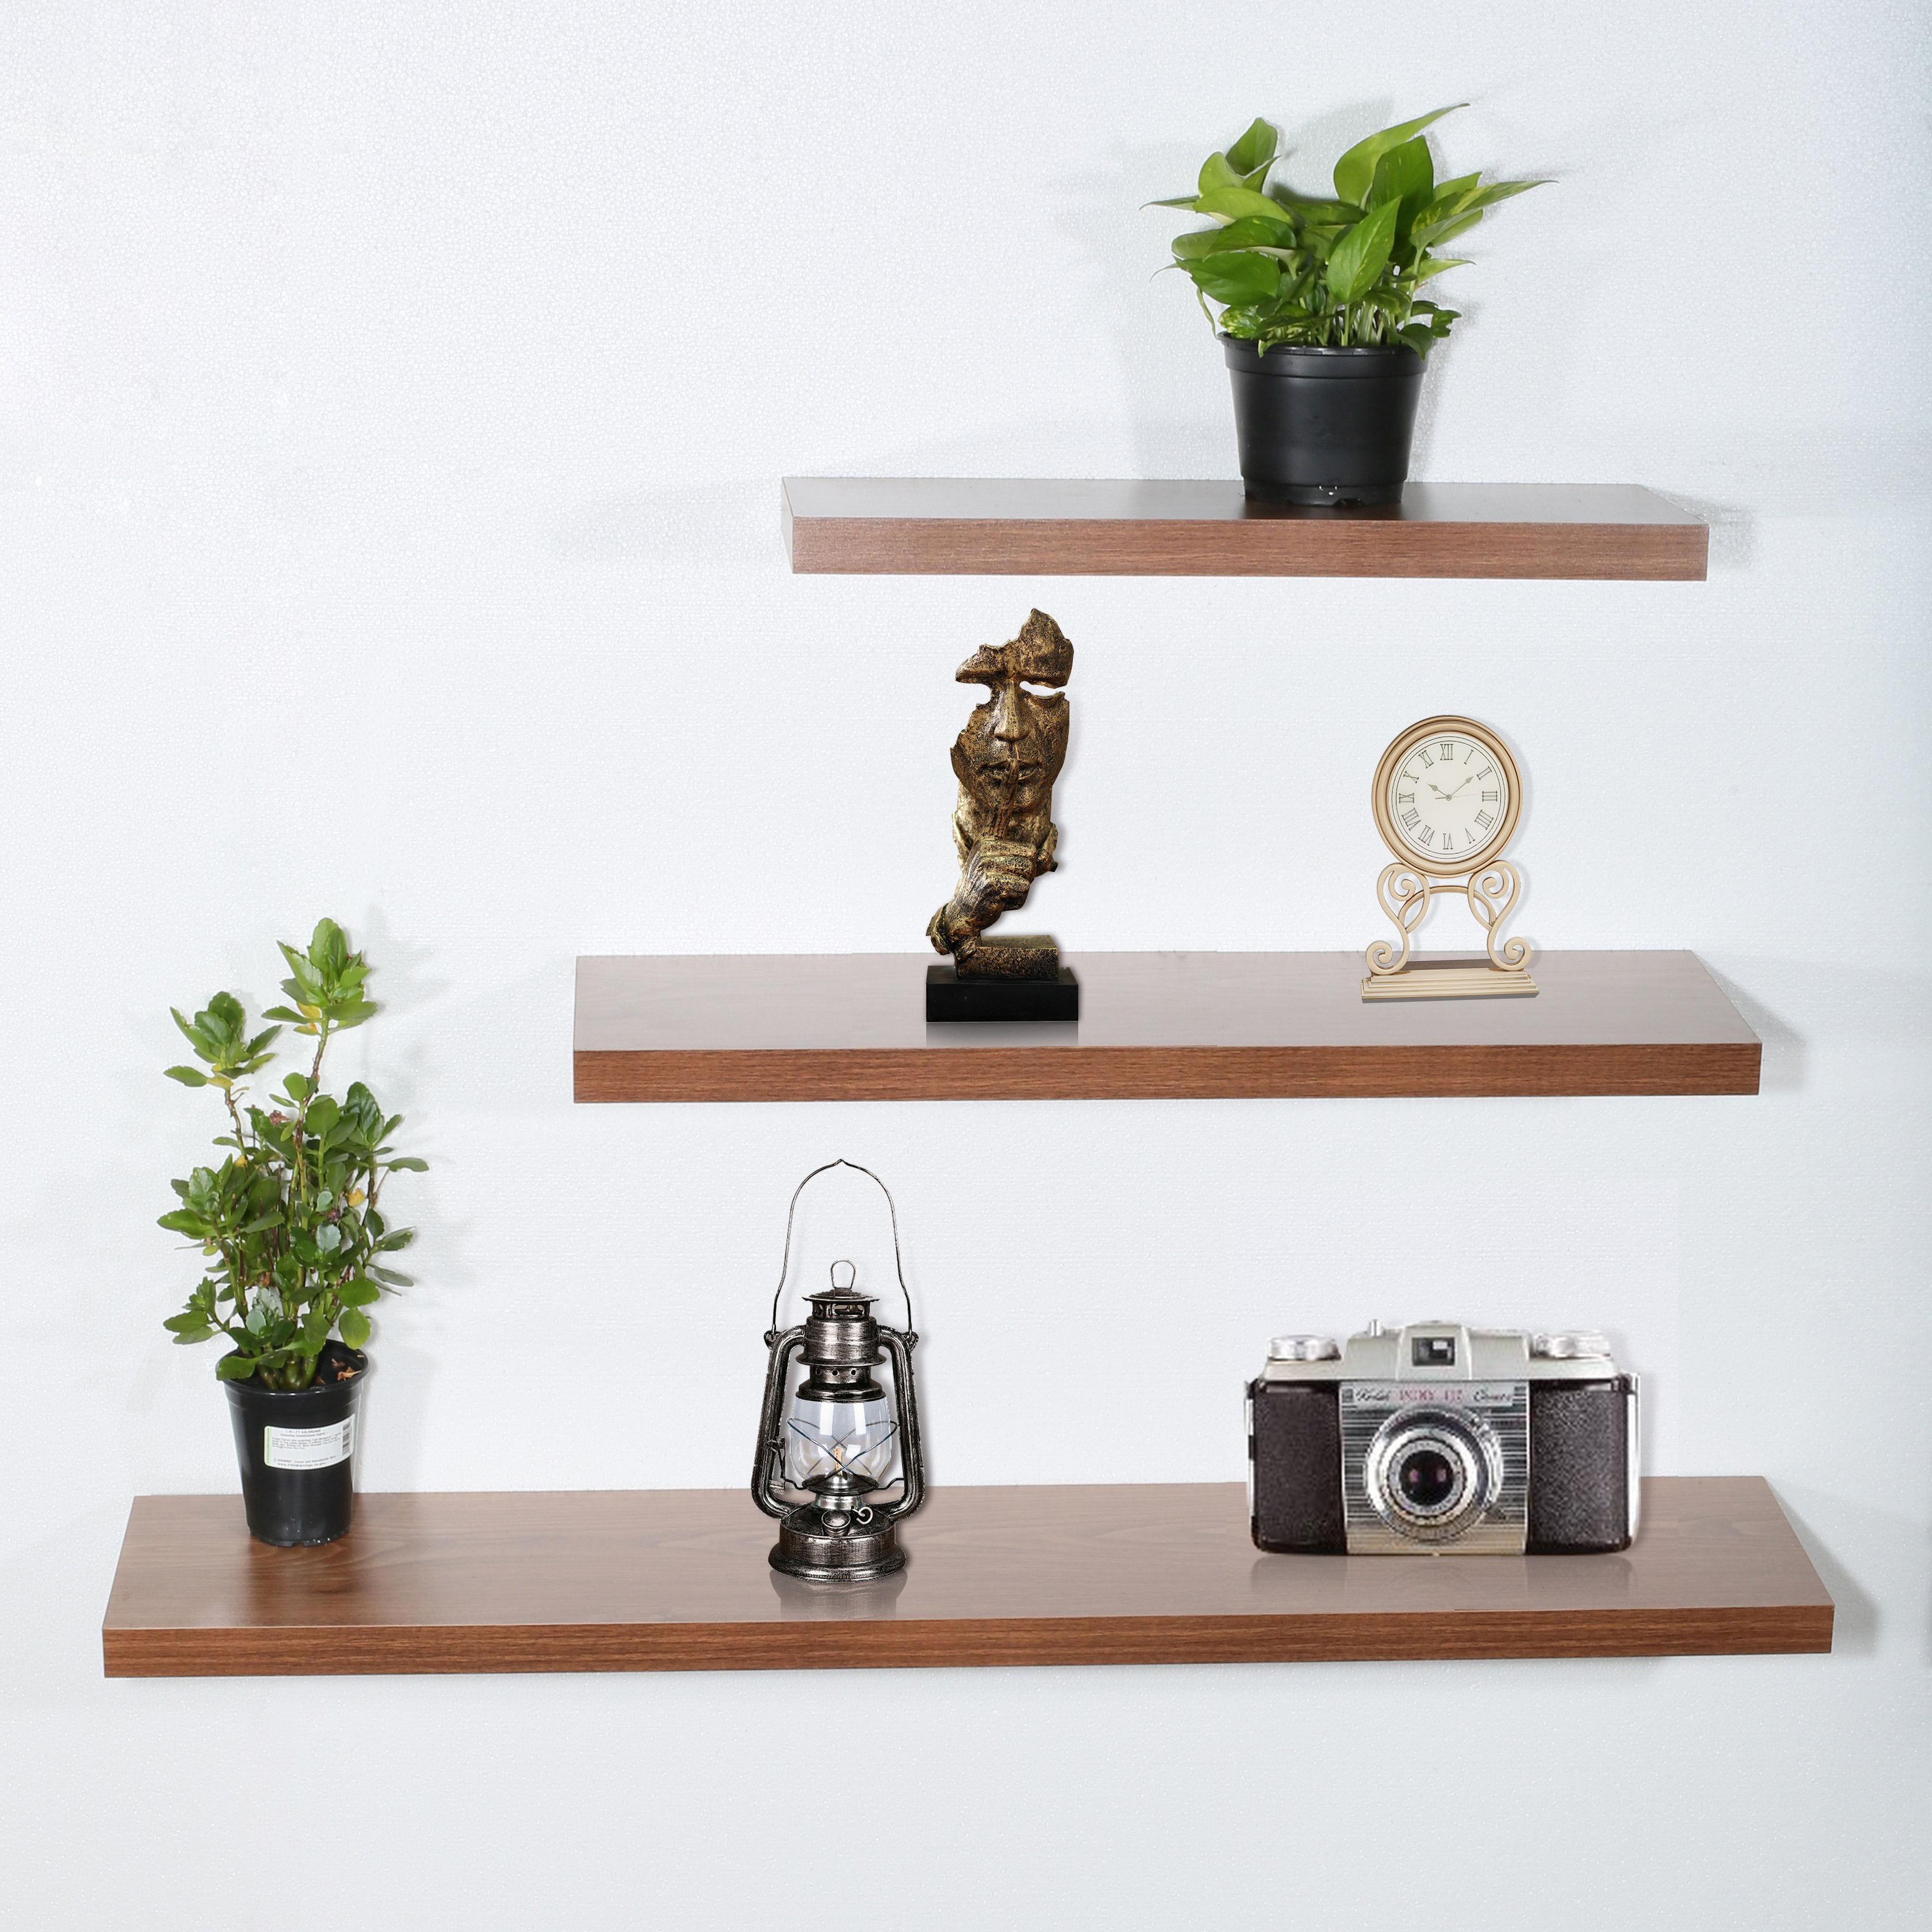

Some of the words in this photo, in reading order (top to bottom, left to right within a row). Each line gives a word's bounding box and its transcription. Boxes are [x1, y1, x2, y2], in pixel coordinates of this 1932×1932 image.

[1418, 749, 1434, 769] XI
[1440, 744, 1454, 761] XII
[1403, 771, 1419, 784] X
[1477, 766, 1492, 781] II
[1399, 792, 1415, 804] IX
[1482, 790, 1498, 802] III
[1401, 807, 1422, 831] VIII
[1474, 810, 1494, 830] IIII
[1418, 825, 1435, 846] VII
[1443, 833, 1454, 850] VI
[1465, 827, 1476, 844] V
